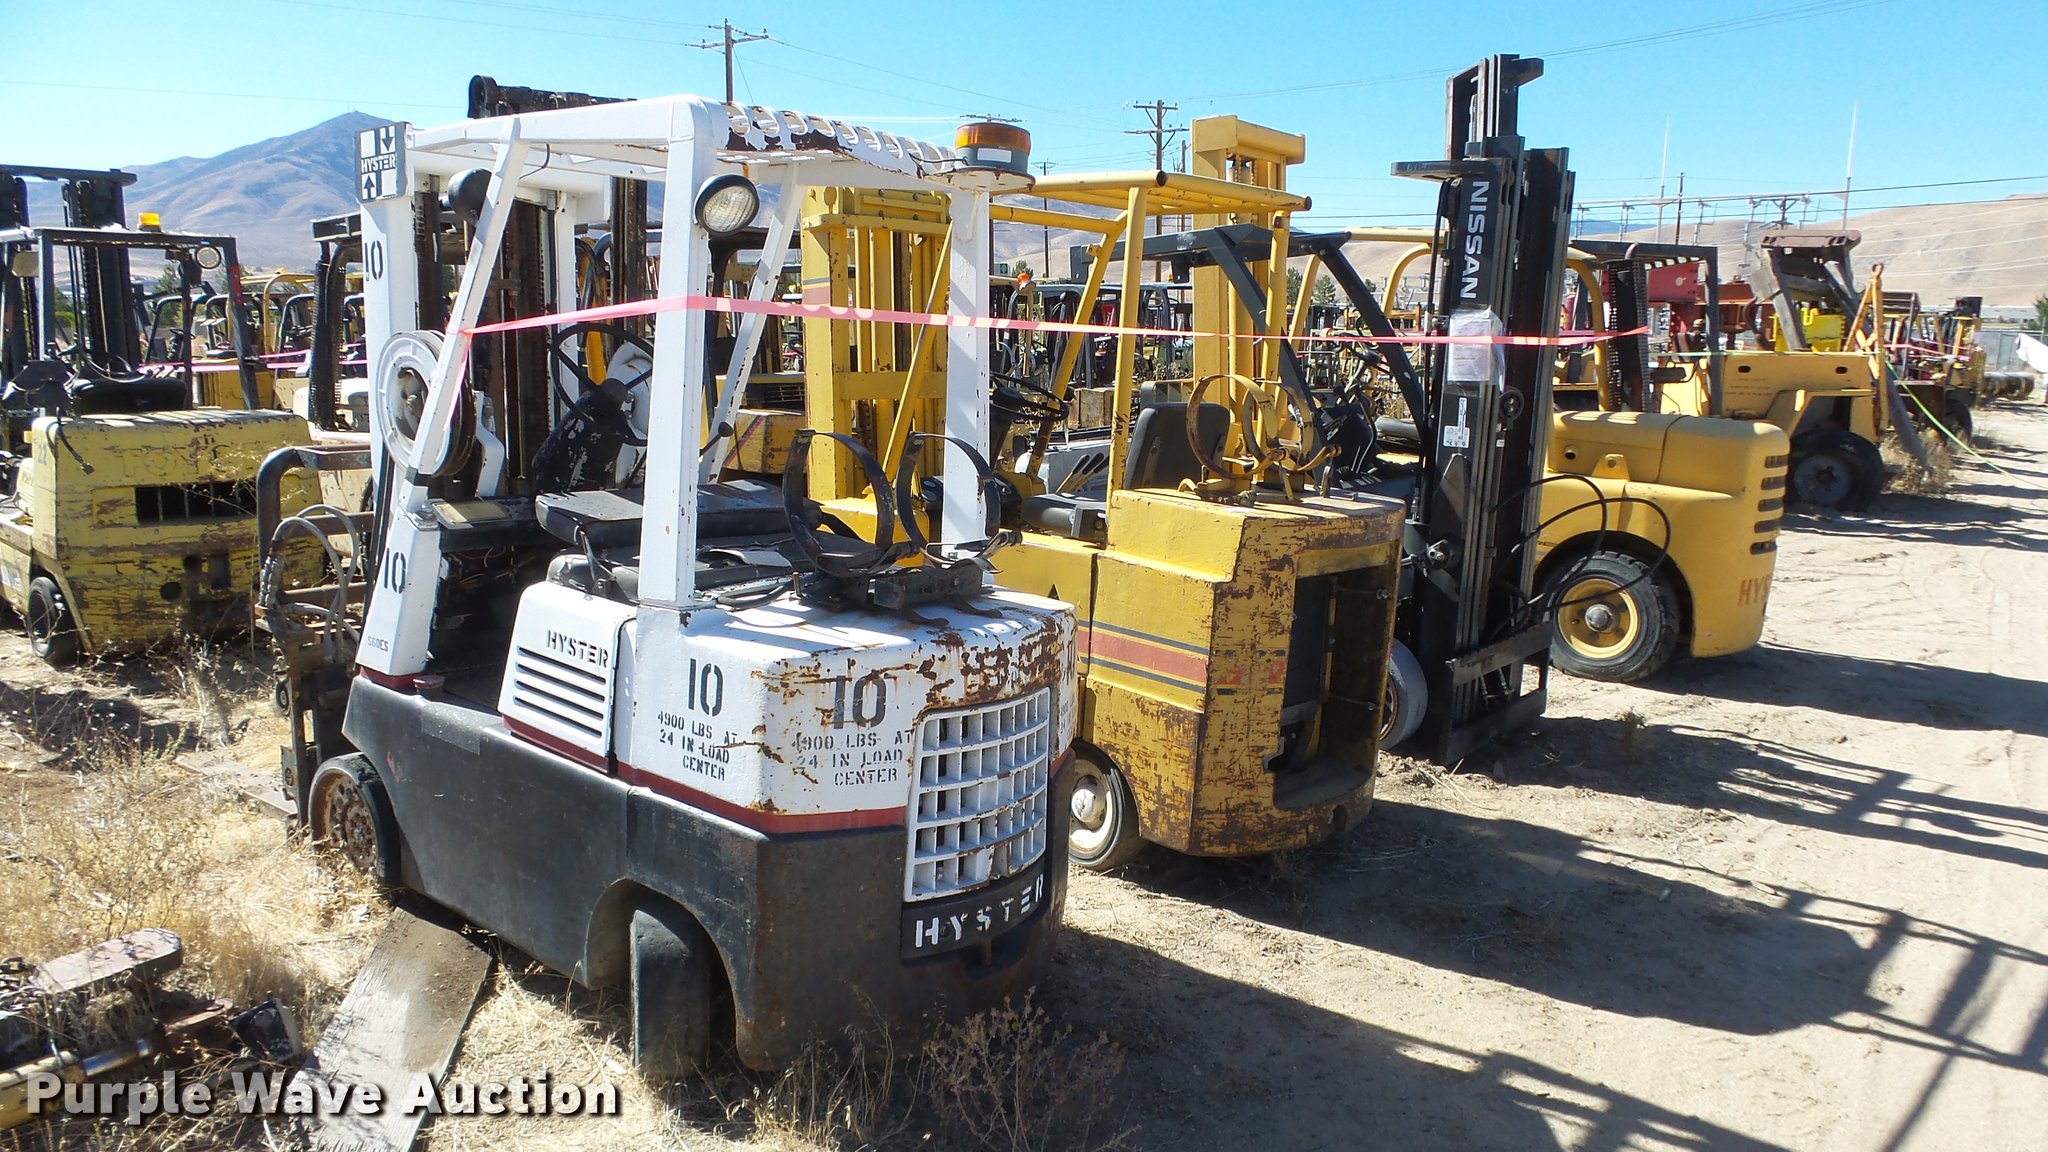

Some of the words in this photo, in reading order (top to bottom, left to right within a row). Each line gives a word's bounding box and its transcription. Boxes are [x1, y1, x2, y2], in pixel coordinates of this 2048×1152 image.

[361, 154, 397, 173] HYSTER
[1460, 181, 1490, 299] NISSAN
[363, 240, 385, 282] 10
[384, 548, 407, 594] 10
[546, 629, 608, 668] HYSTER
[688, 658, 723, 717] 10
[833, 675, 887, 730] 10
[657, 710, 685, 731] 4900
[691, 717, 713, 740] LBS
[723, 732, 739, 745] AT
[659, 728, 674, 746] 24
[681, 735, 694, 752] IN
[701, 743, 730, 764] LOAD
[846, 733, 877, 748] LBS
[895, 730, 912, 745] AT
[682, 754, 726, 781] CENTER
[832, 753, 850, 768] IN
[862, 749, 903, 766] LOAD
[834, 768, 898, 786] CENTER
[915, 874, 1044, 948] HYSTER
